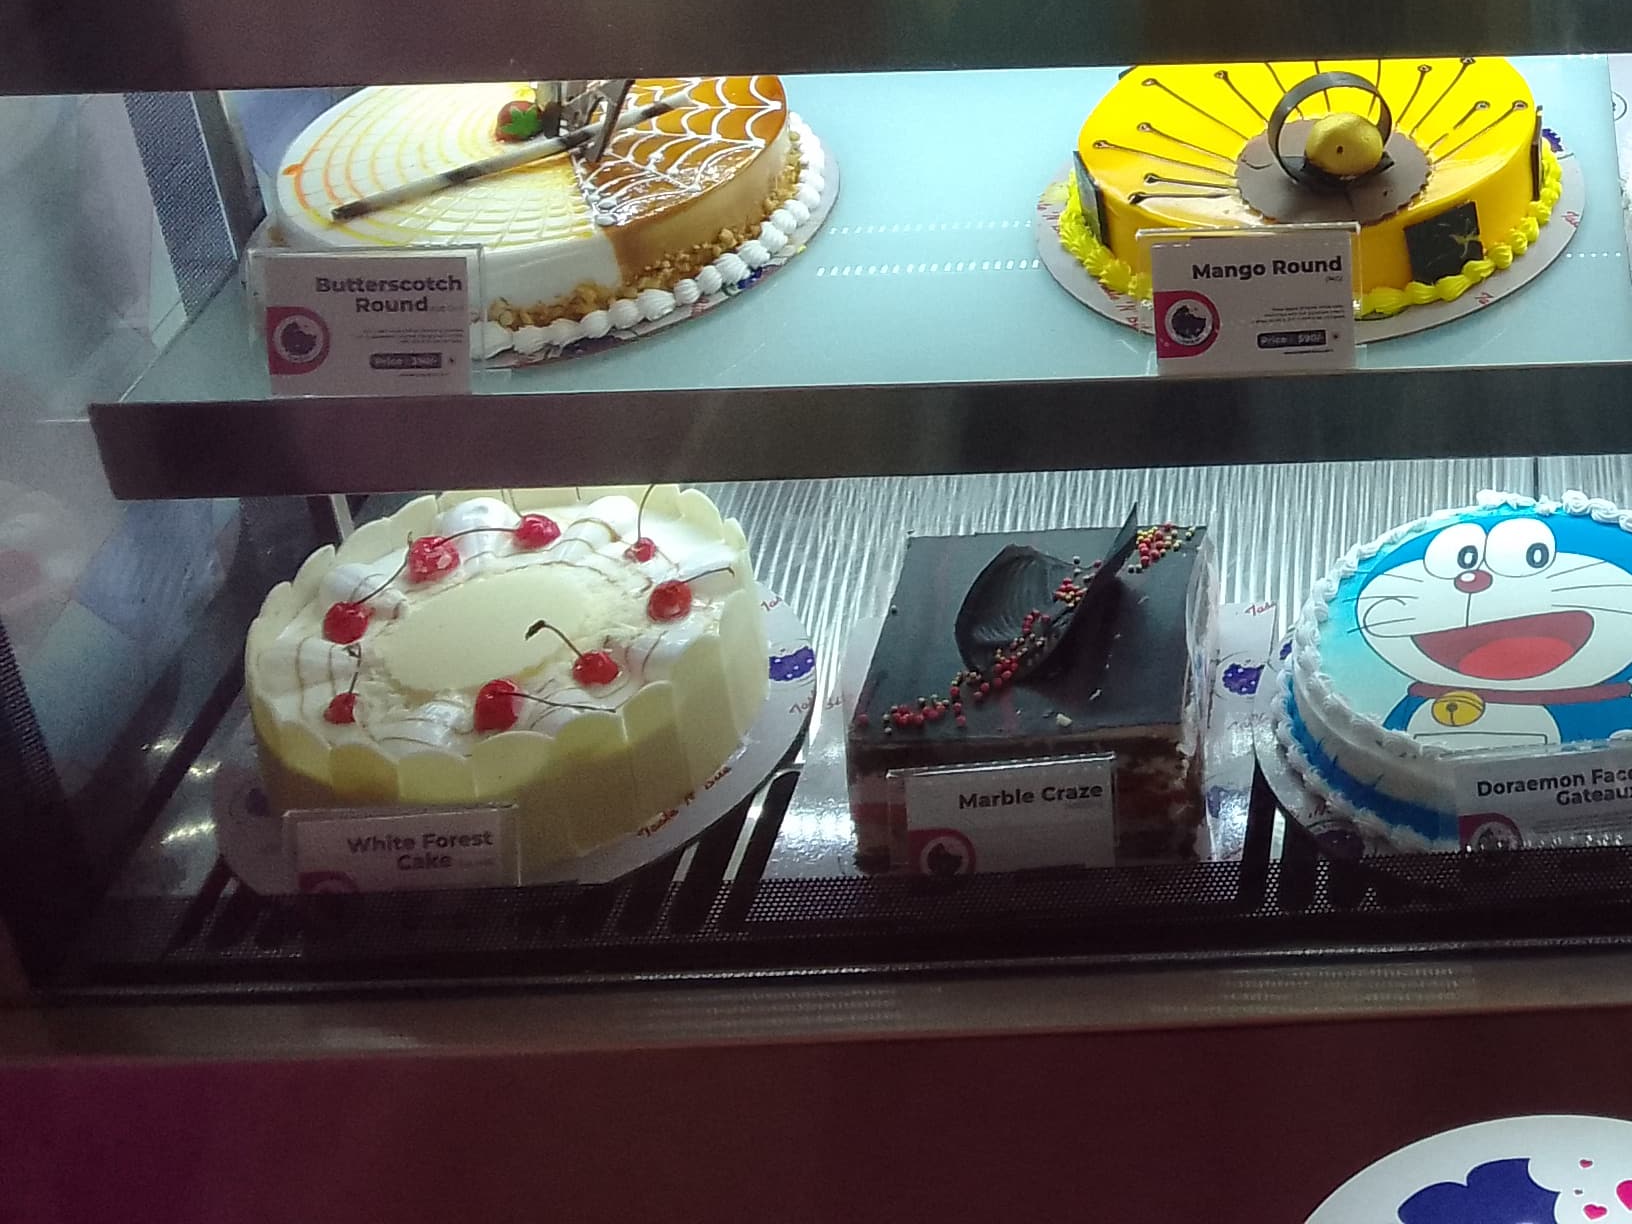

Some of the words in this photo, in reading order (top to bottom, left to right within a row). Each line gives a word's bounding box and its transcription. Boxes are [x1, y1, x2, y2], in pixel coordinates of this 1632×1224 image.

[1192, 263, 1266, 281] Mango
[1272, 255, 1343, 275] Round
[315, 275, 462, 293] Butterscotch
[355, 296, 428, 313] Round
[959, 788, 1034, 809] Marble
[1042, 784, 1103, 802] Craze
[1477, 774, 1585, 797] Doraemon
[347, 836, 416, 853] White
[422, 830, 494, 849] Forest
[397, 853, 452, 871] Cake
